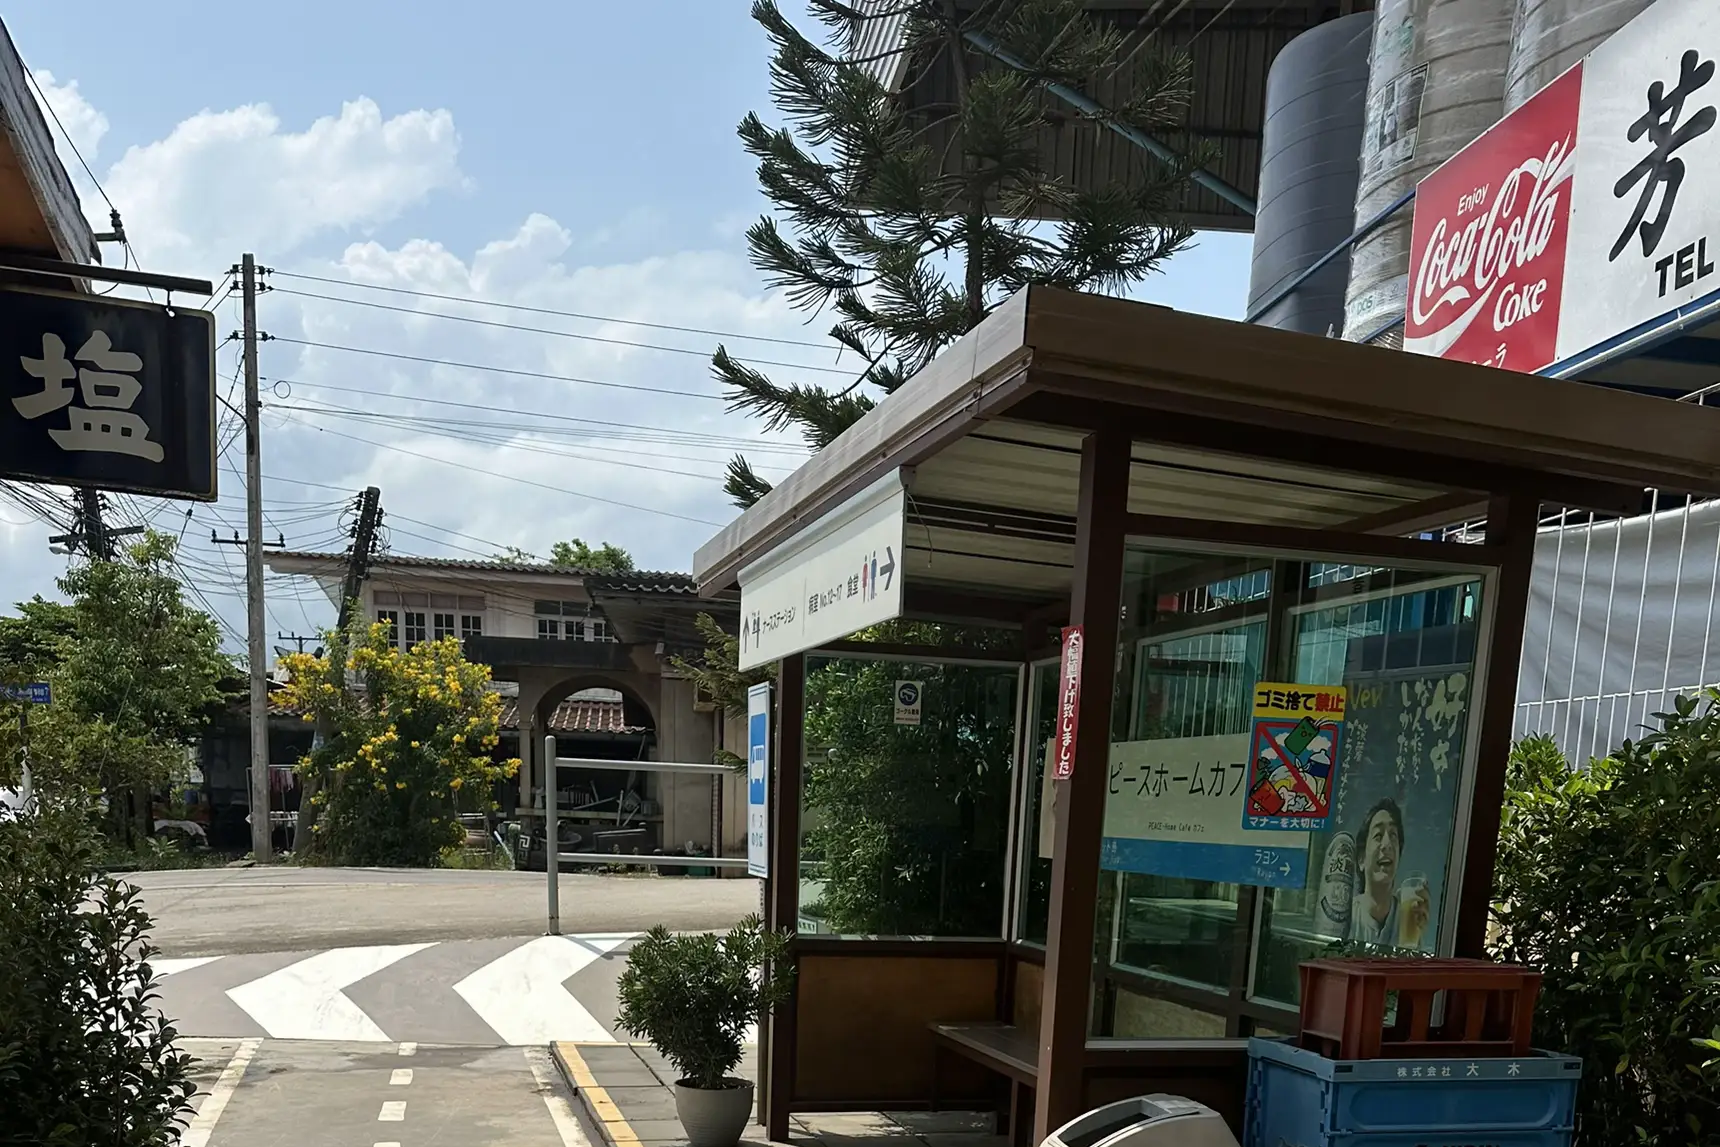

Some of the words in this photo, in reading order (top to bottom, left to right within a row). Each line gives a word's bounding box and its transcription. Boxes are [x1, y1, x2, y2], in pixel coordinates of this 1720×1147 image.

[1609, 49, 1717, 263] 芳
[1457, 182, 1490, 217] Enjoy
[1412, 131, 1572, 326] Coca-Cola
[1655, 236, 1715, 298] TEL
[1493, 278, 1547, 332] Coke
[11, 329, 165, 463] 塩
[762, 606, 796, 634] ナースステーション
[1256, 690, 1344, 713] ゴミ捨て禁止
[1109, 761, 1246, 797] ピースホームカフ
[1254, 849, 1280, 864] ラヨン
[1397, 1066, 1452, 1078] 株式会社
